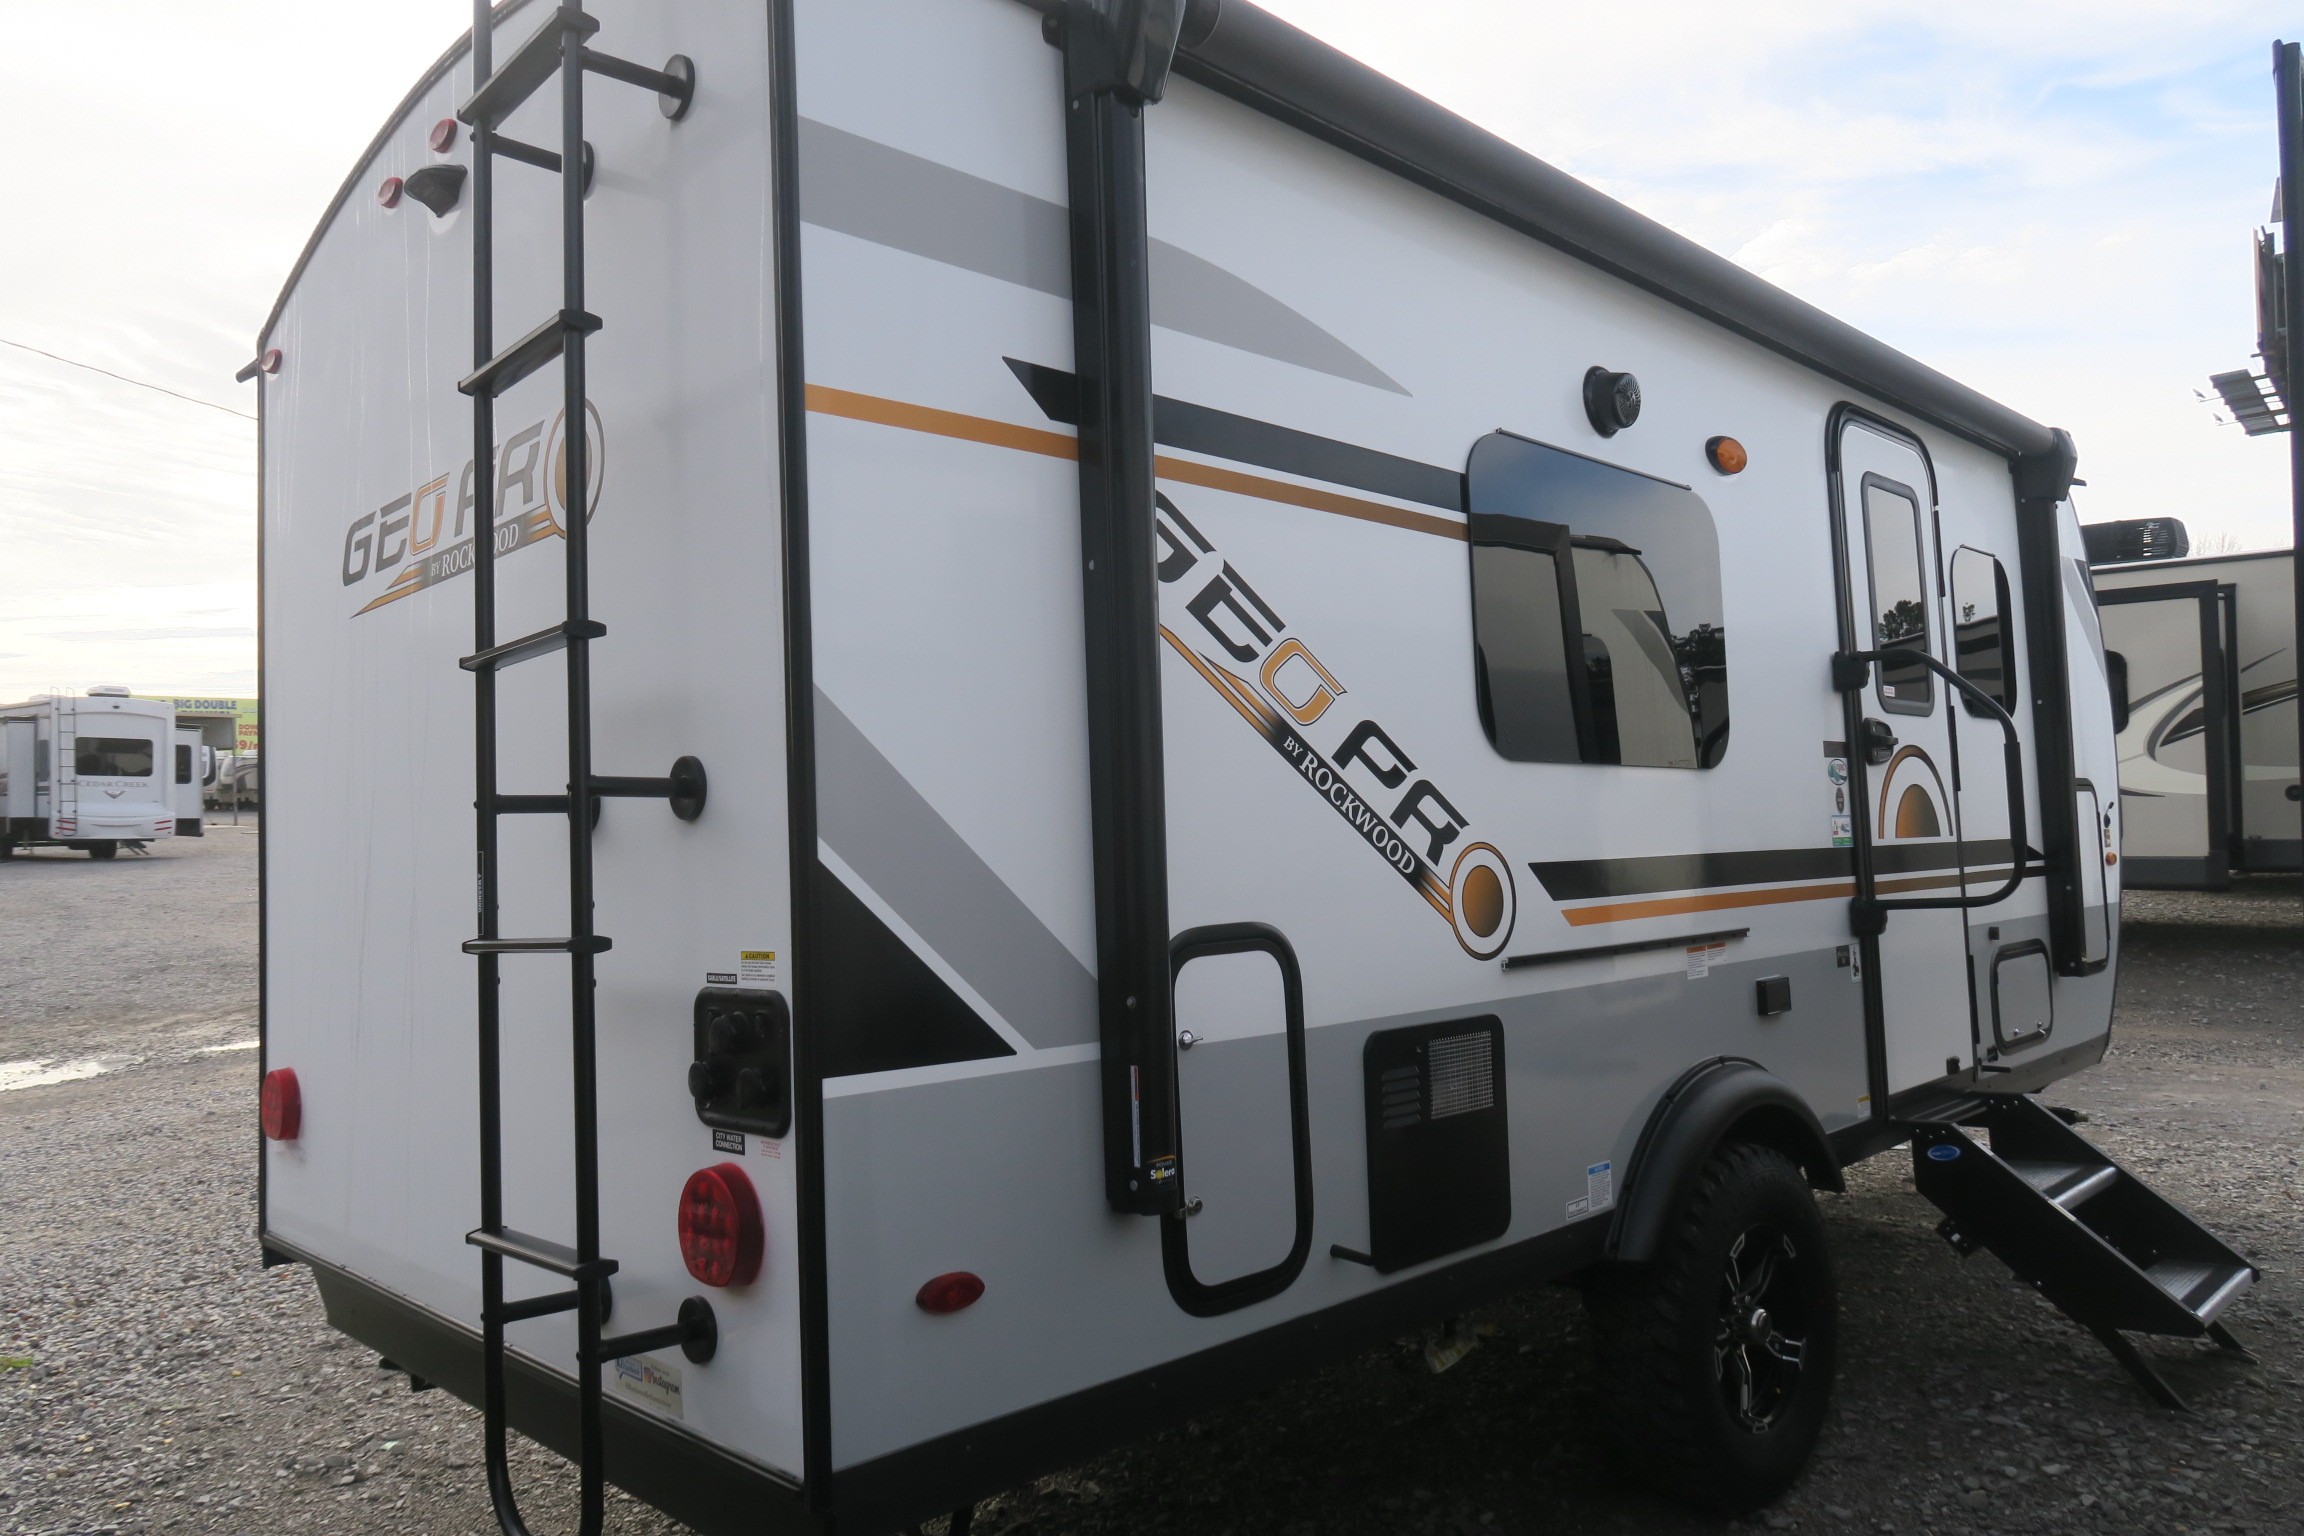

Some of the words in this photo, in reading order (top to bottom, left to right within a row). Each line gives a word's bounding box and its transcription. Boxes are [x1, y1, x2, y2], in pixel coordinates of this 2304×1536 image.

[342, 471, 450, 587] GEO
[431, 561, 441, 576] BY
[441, 523, 519, 577] ROCKOD
[173, 699, 192, 709] BIG
[194, 700, 237, 709] DOUBLE
[1283, 735, 1303, 758] BY
[1300, 750, 1416, 875] ROCKWOOD
[1331, 719, 1517, 961] PRO
[749, 952, 770, 960] CAUTION
[715, 1131, 726, 1140] CITY
[726, 1133, 742, 1143] WATER
[715, 1139, 743, 1151] CONNECTION
